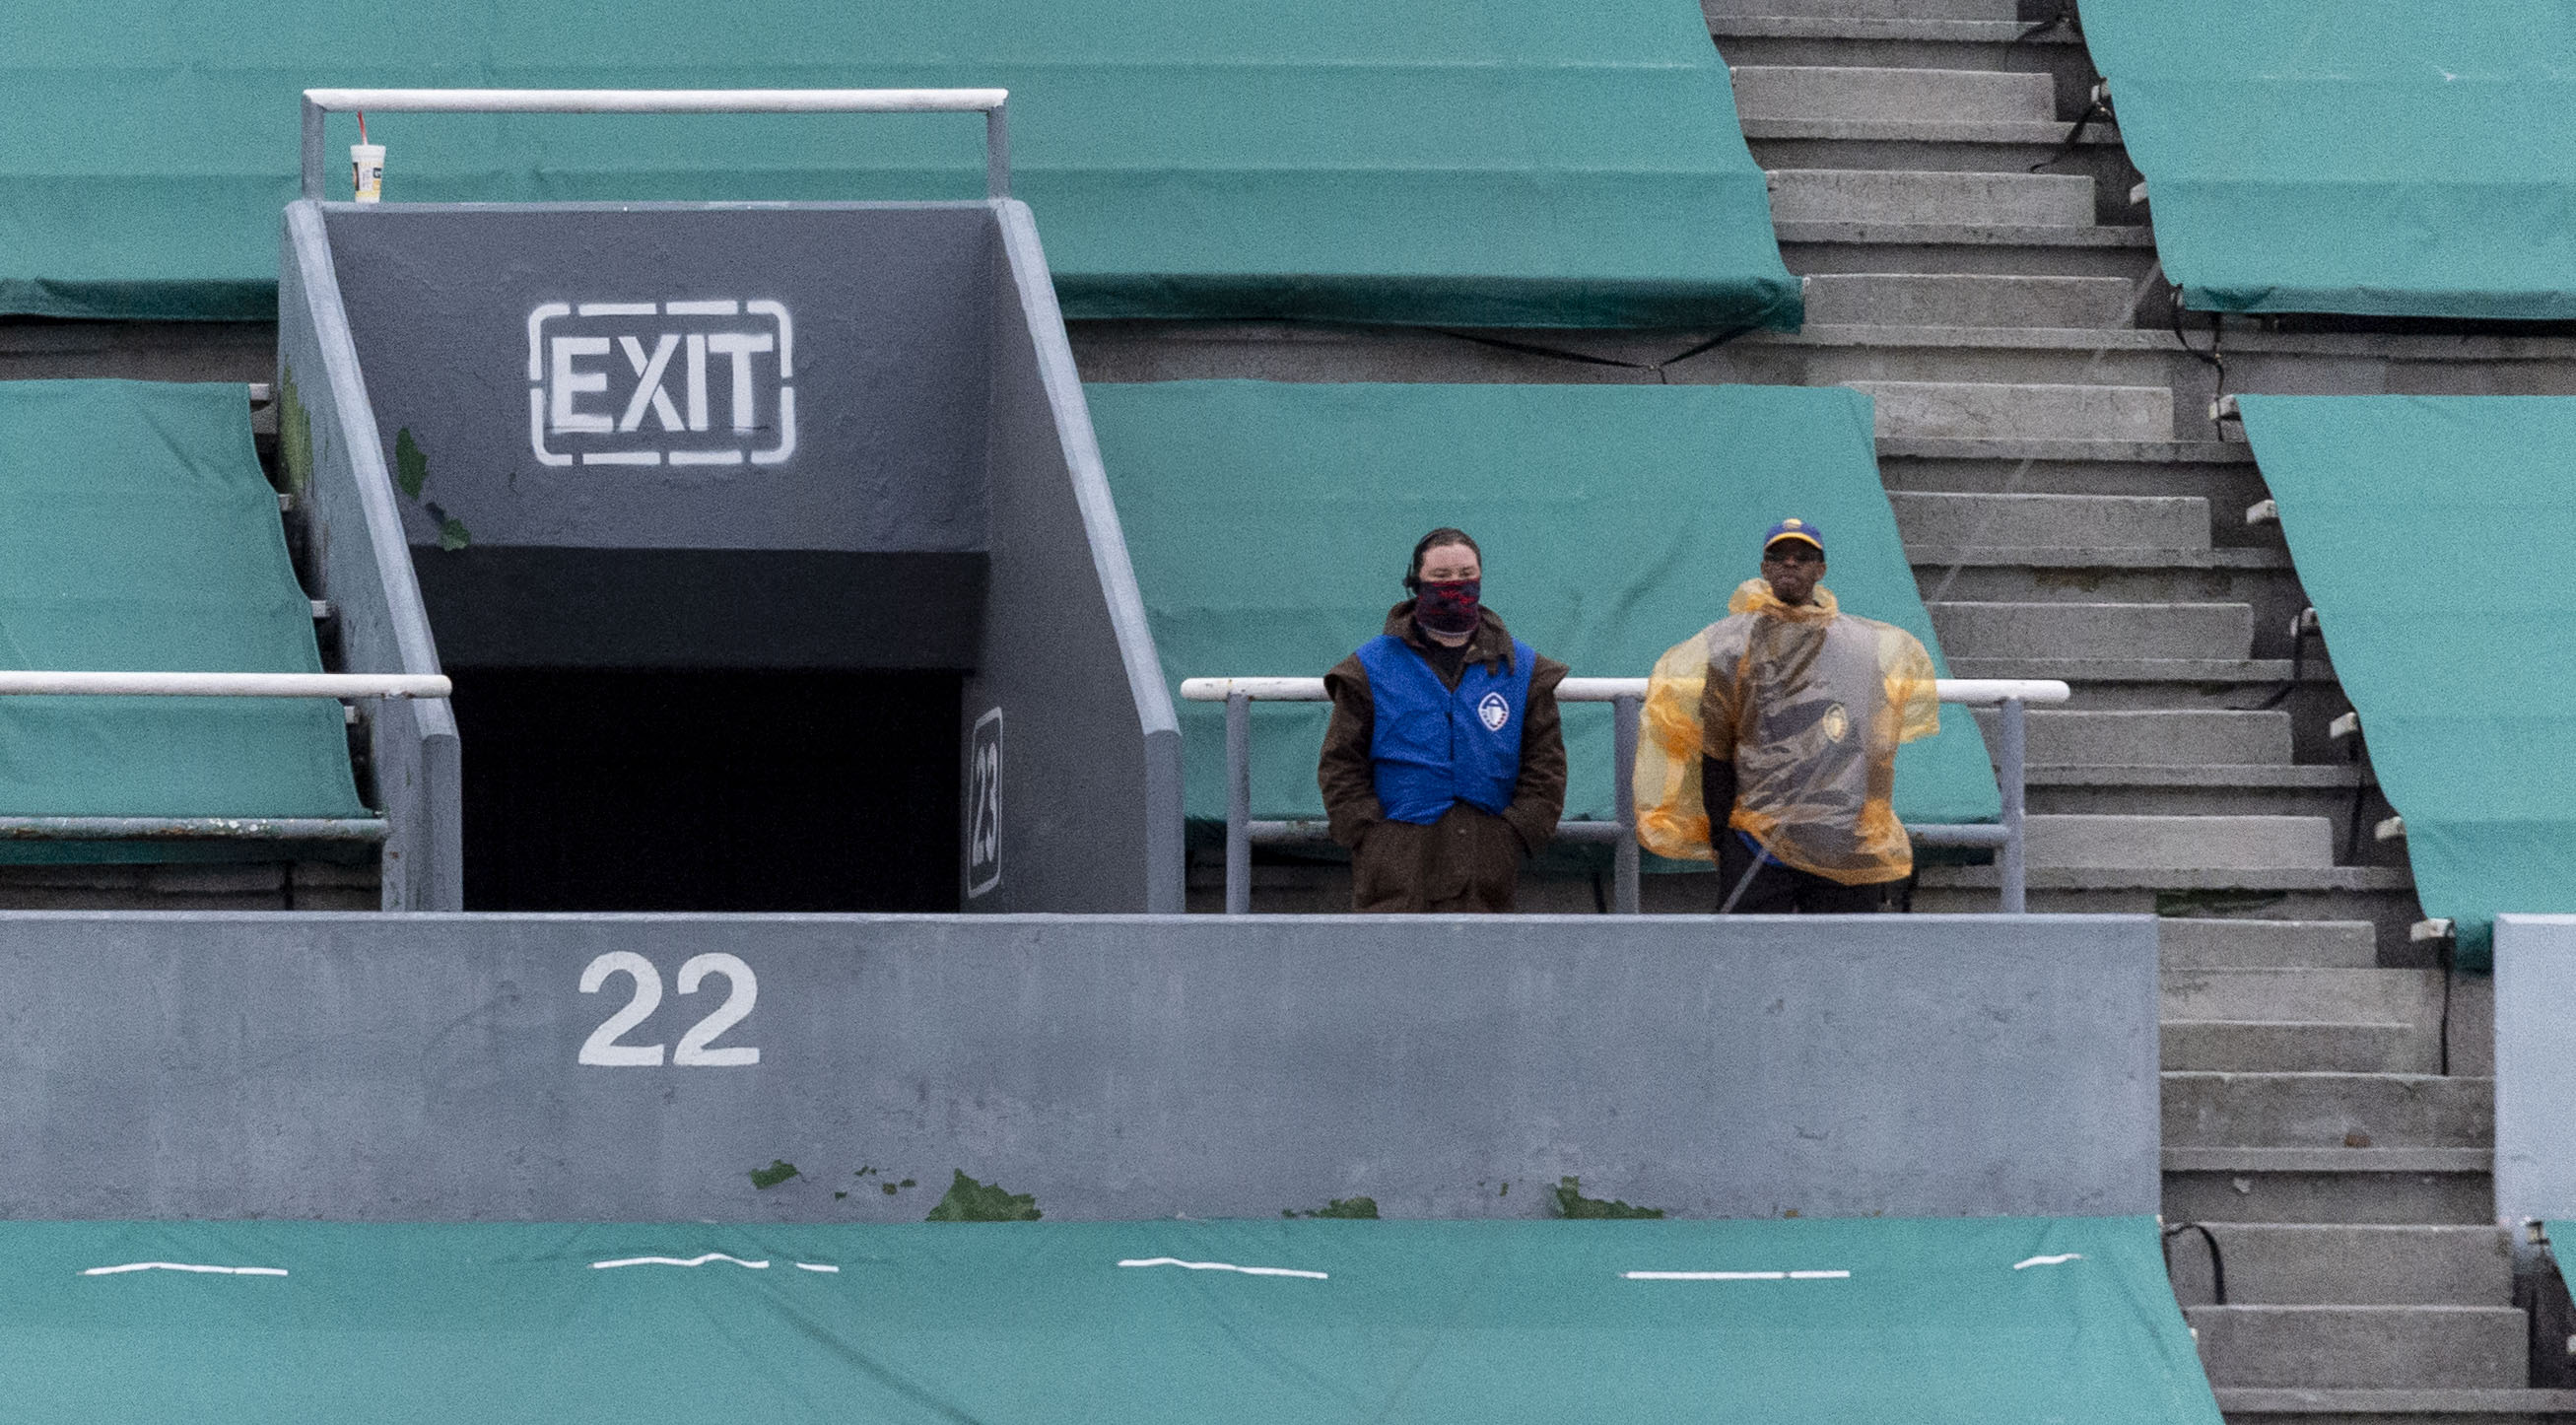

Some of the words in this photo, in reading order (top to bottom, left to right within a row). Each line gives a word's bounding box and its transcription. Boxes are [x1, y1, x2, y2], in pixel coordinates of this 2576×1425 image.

[552, 333, 775, 435] EXIT
[972, 741, 998, 867] 23
[577, 950, 761, 1066] 22
